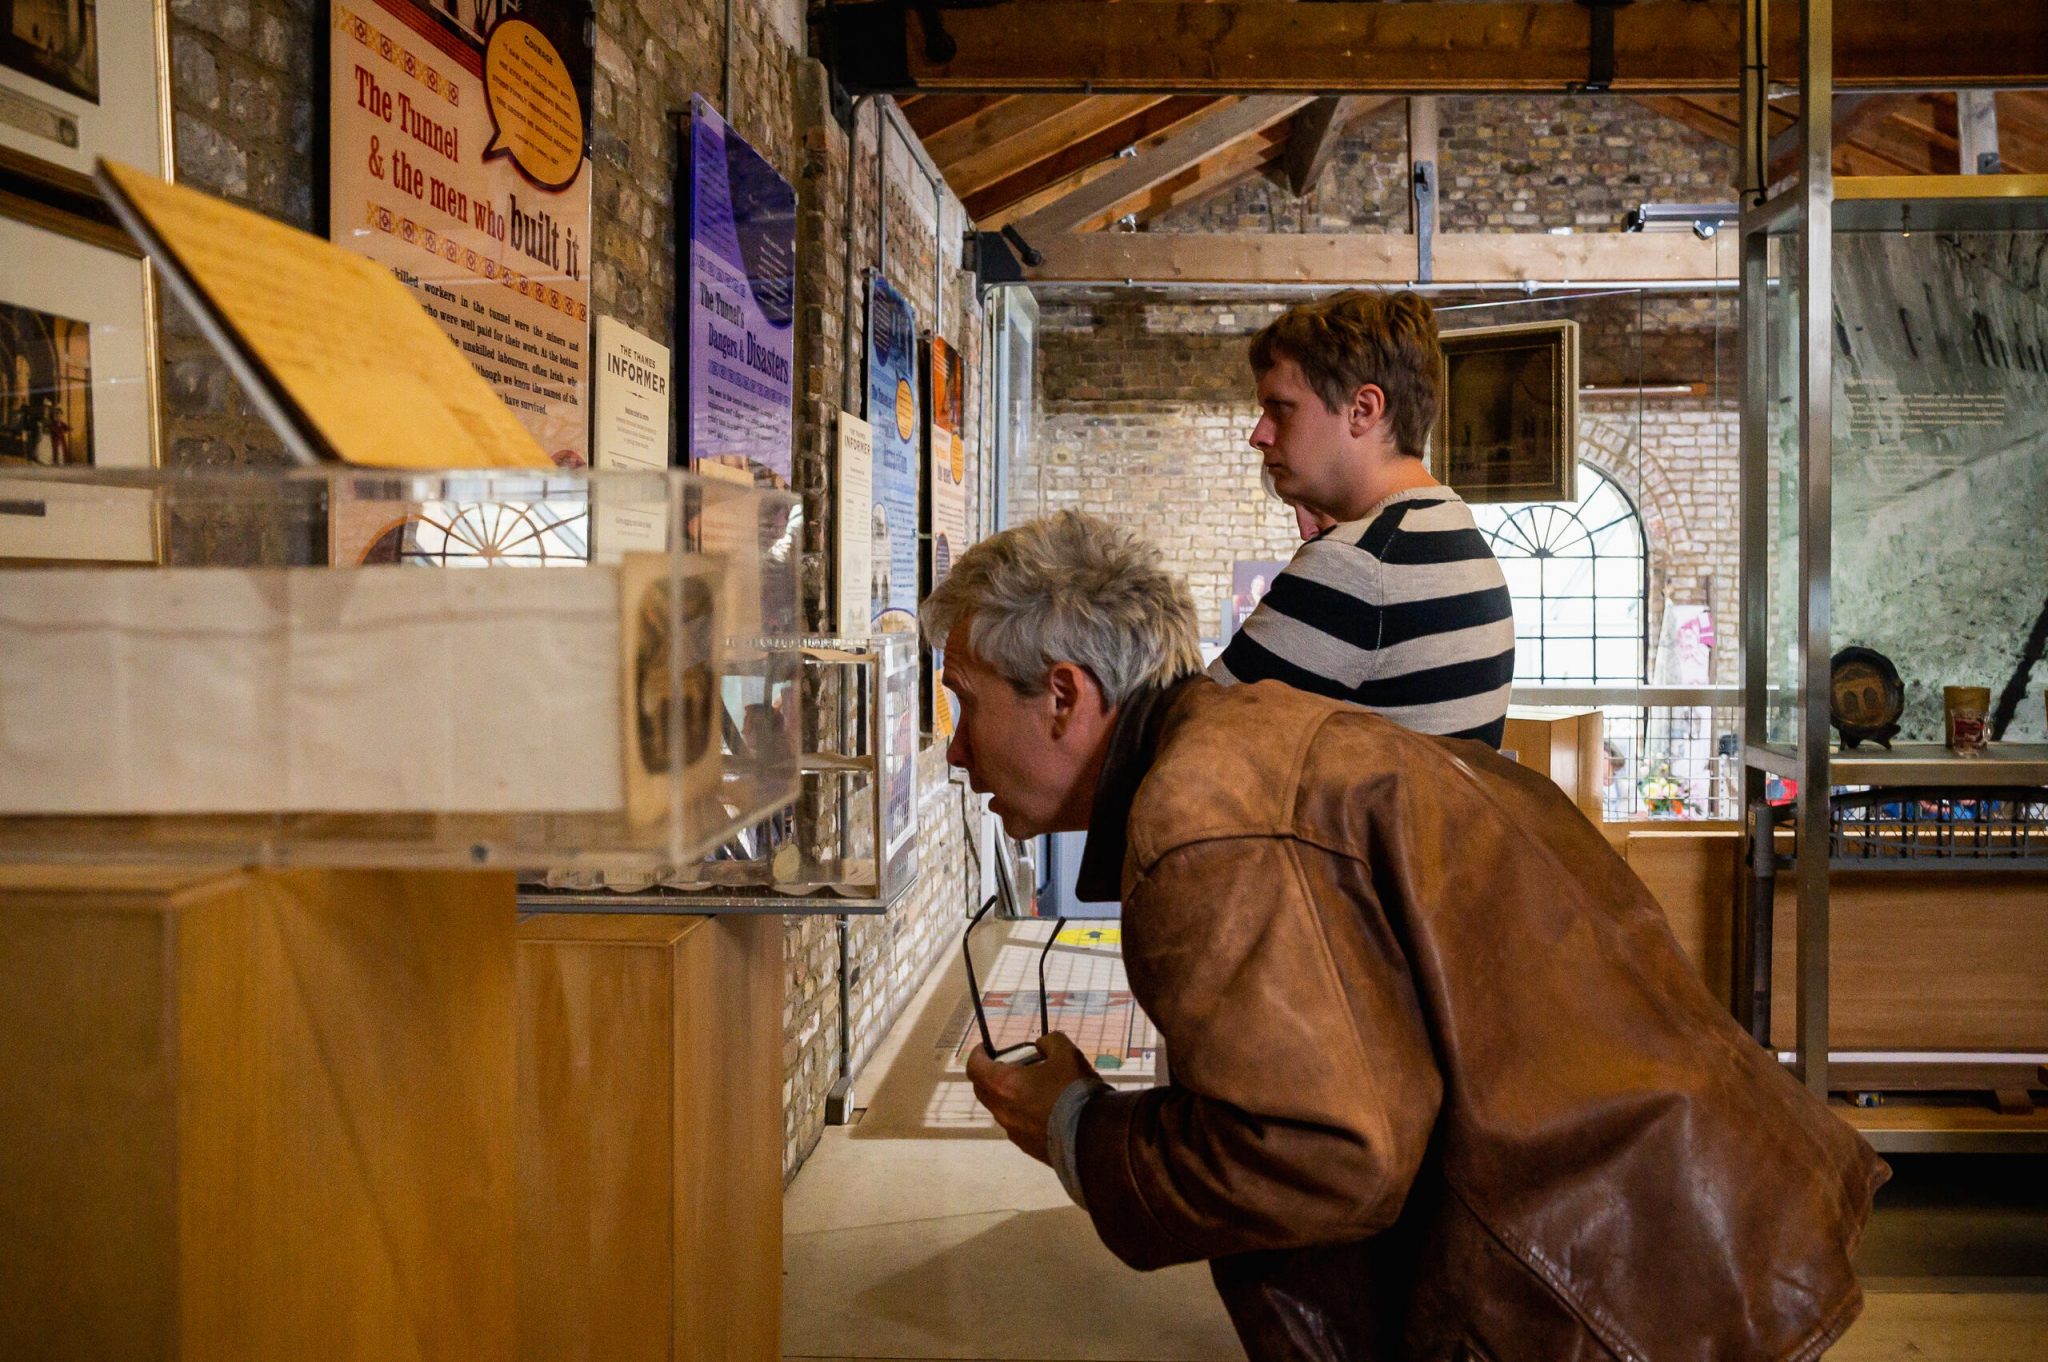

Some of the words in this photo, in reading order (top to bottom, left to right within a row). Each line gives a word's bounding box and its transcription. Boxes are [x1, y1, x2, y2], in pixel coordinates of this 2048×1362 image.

[355, 64, 392, 123] The
[398, 92, 458, 163] Tunnel
[368, 135, 384, 180] &
[392, 150, 423, 200] the
[430, 176, 467, 223] men
[473, 200, 504, 242] who
[510, 193, 559, 271] built
[566, 227, 579, 281] it
[390, 267, 419, 288] killed
[424, 282, 456, 303] workers
[461, 294, 468, 308] in
[473, 300, 484, 314] the
[489, 307, 510, 324] tunnel
[515, 320, 529, 332] were
[533, 325, 542, 337] the
[546, 332, 565, 346] miners
[569, 341, 579, 352] and
[700, 281, 714, 311] The
[440, 311, 458, 325] were
[461, 319, 475, 332] well
[477, 324, 492, 338] paid
[494, 329, 503, 342] for
[505, 334, 520, 348] their
[549, 351, 558, 362] the
[560, 354, 578, 370] bottom
[448, 333, 459, 348] he
[463, 341, 494, 359] unskilled
[532, 363, 547, 377] often
[621, 345, 631, 358] THE
[633, 351, 656, 369] THAMES
[708, 322, 737, 359] Dangers
[747, 330, 788, 384] Disasters
[472, 362, 501, 384] lthough
[504, 375, 512, 385] we
[514, 376, 530, 390] know
[532, 382, 542, 394] the
[543, 388, 561, 400] names
[563, 393, 568, 402] of
[608, 352, 666, 395] INFORMER
[505, 393, 519, 407] have
[845, 434, 870, 455] INFORMER
